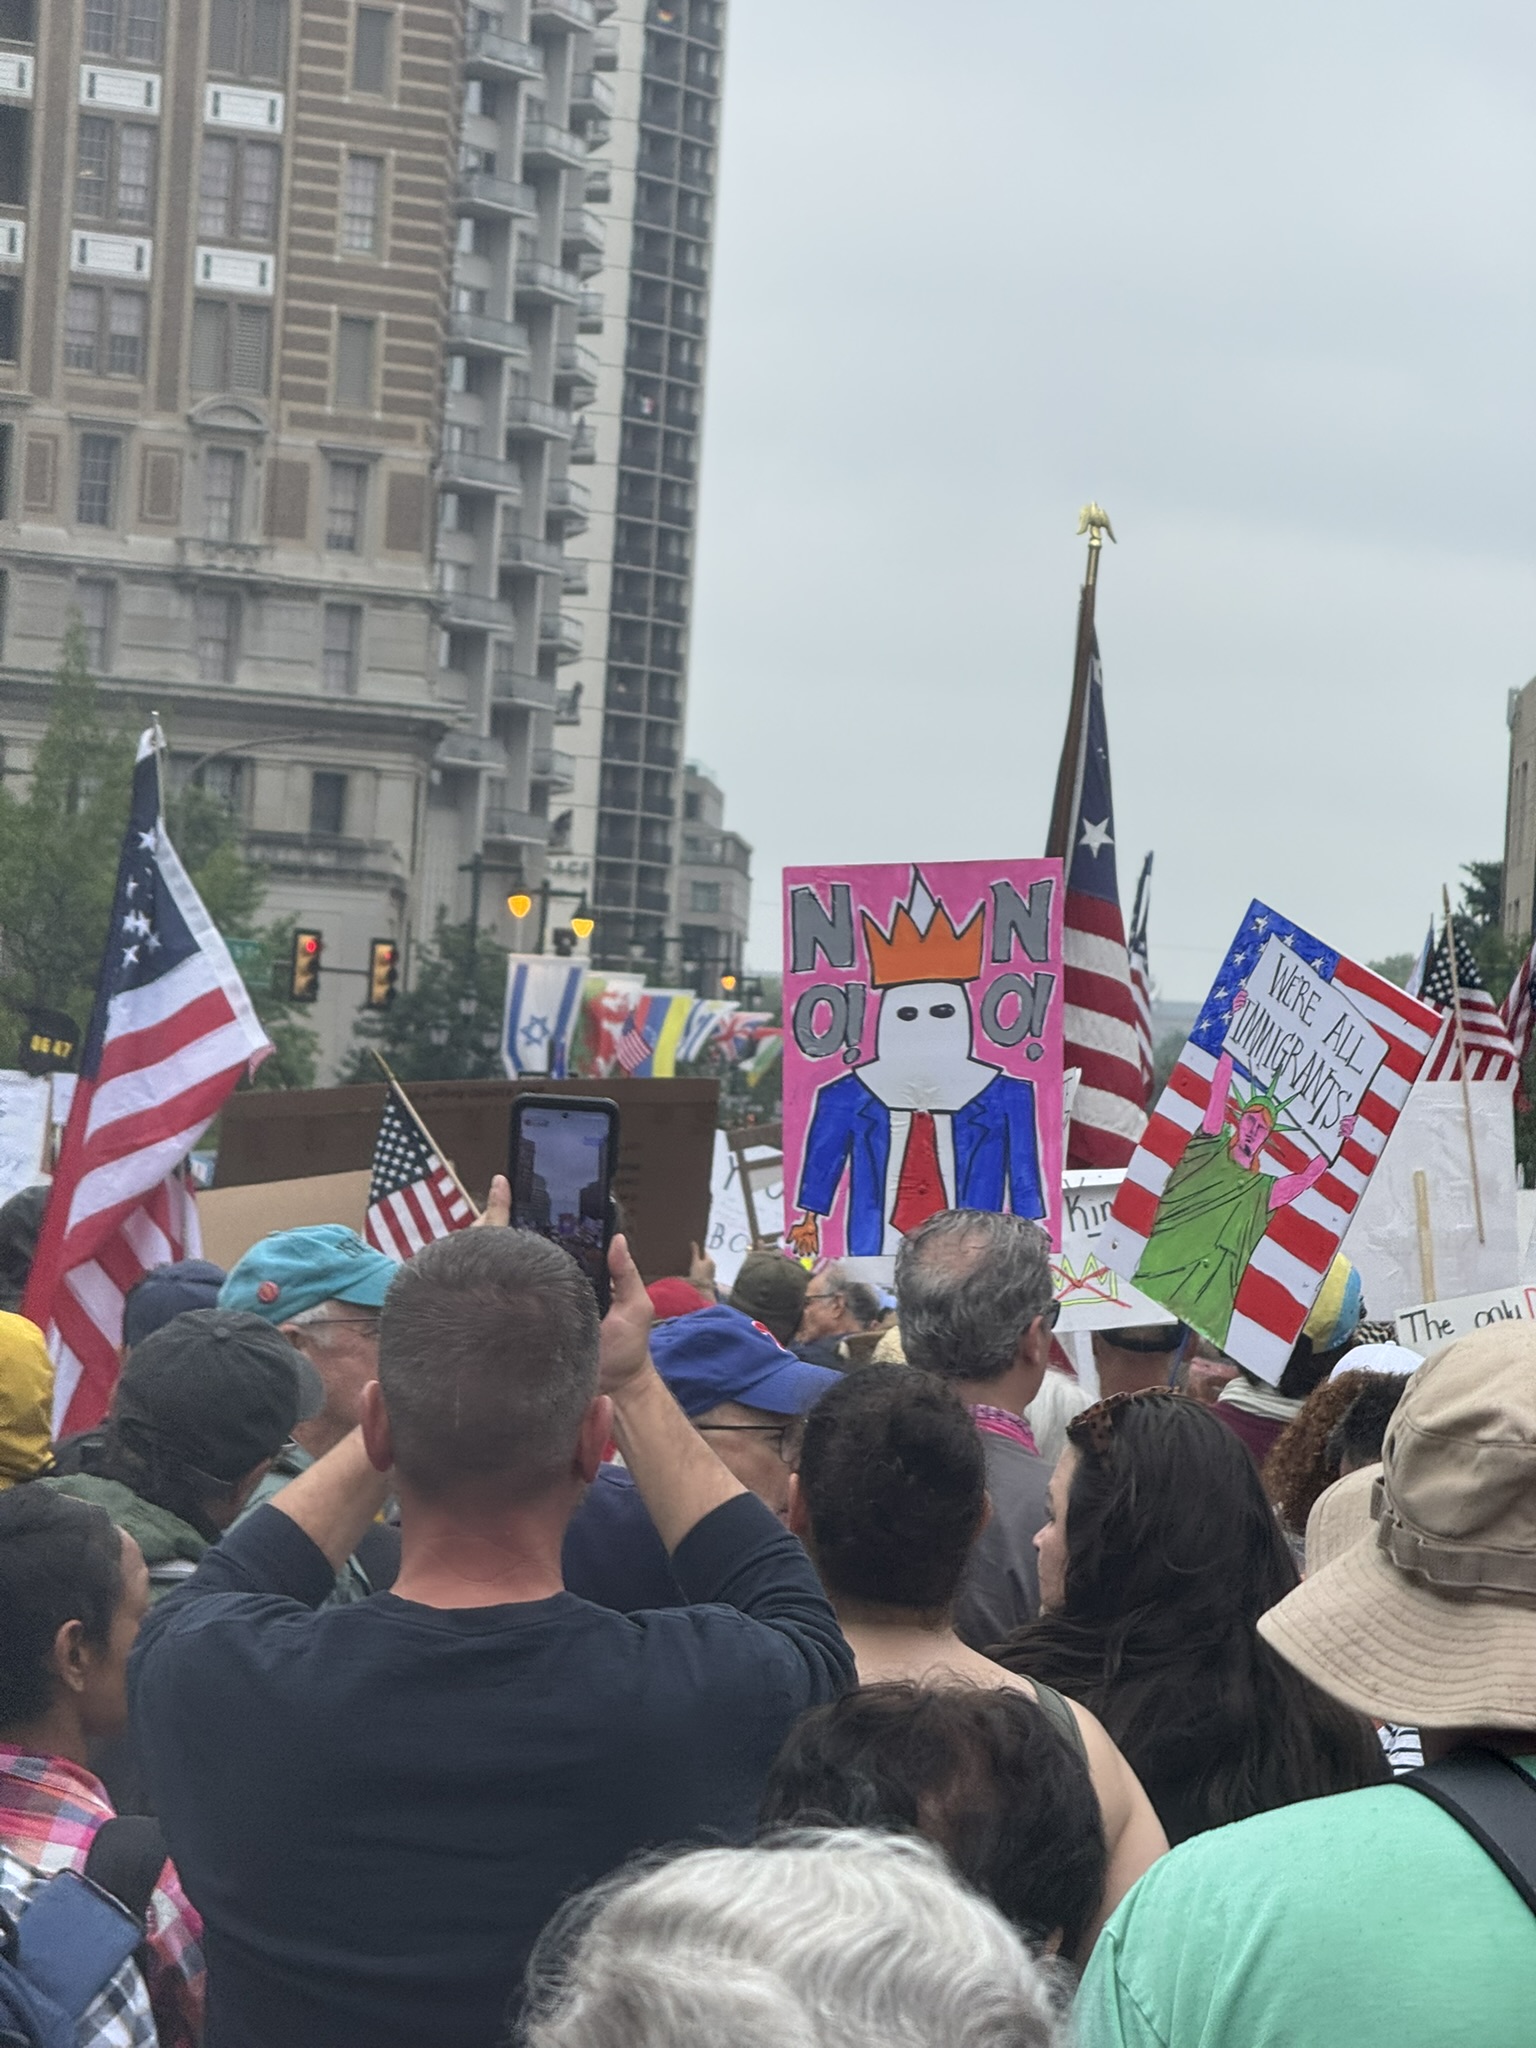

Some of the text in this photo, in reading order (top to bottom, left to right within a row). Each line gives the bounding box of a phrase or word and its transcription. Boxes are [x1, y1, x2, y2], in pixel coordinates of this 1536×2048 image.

[790, 883, 855, 973] N
[990, 880, 1054, 964] N
[792, 982, 867, 1064] O!
[980, 972, 1056, 1062] O!
[1322, 1012, 1365, 1075] ALL
[1229, 998, 1352, 1130] IMMIGRANTS
[1065, 1195, 1113, 1232] Kin
[1399, 1309, 1455, 1343] The
